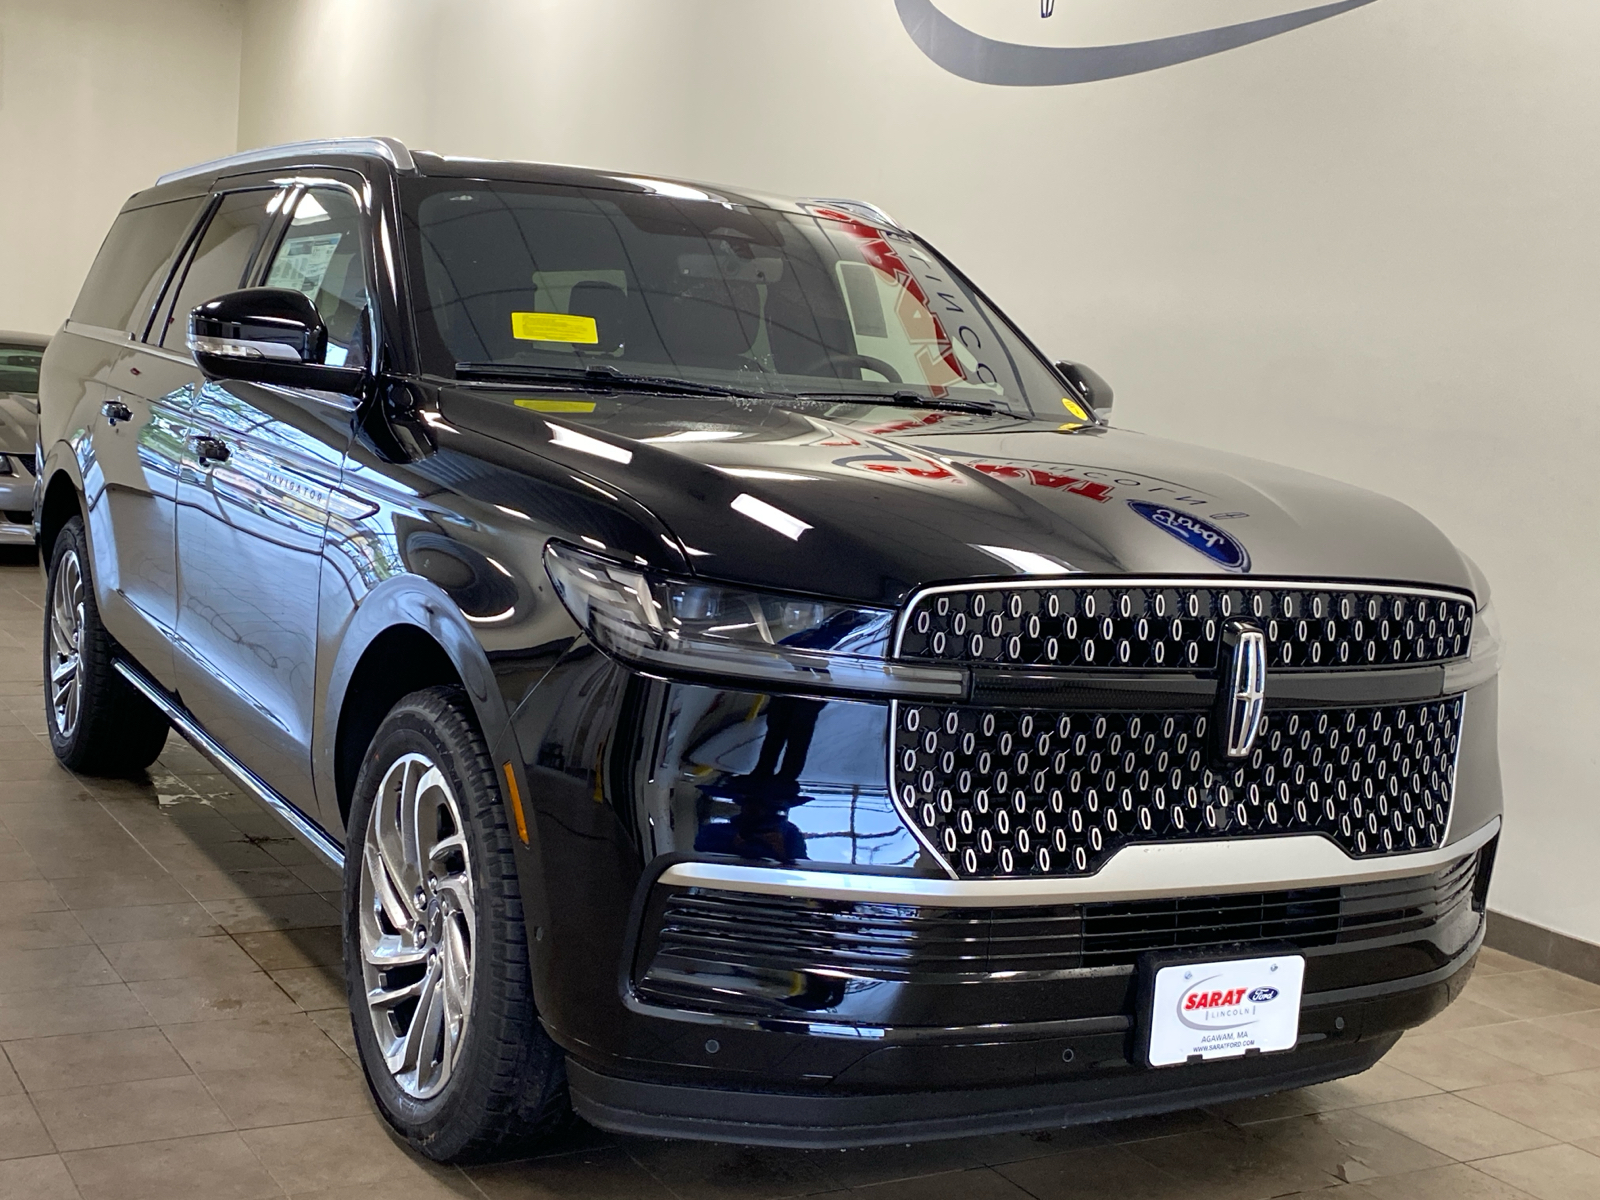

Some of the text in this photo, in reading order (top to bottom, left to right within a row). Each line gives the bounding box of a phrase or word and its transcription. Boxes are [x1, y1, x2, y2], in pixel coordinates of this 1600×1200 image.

[265, 472, 322, 502] NAVIGATOR
[1184, 987, 1276, 1011] SARAT Ford
[1211, 1009, 1249, 1018] LINCOLN
[1201, 1031, 1249, 1044] AGAWAM, MA
[1193, 1040, 1255, 1052] WWW.SARATFORD.COM
